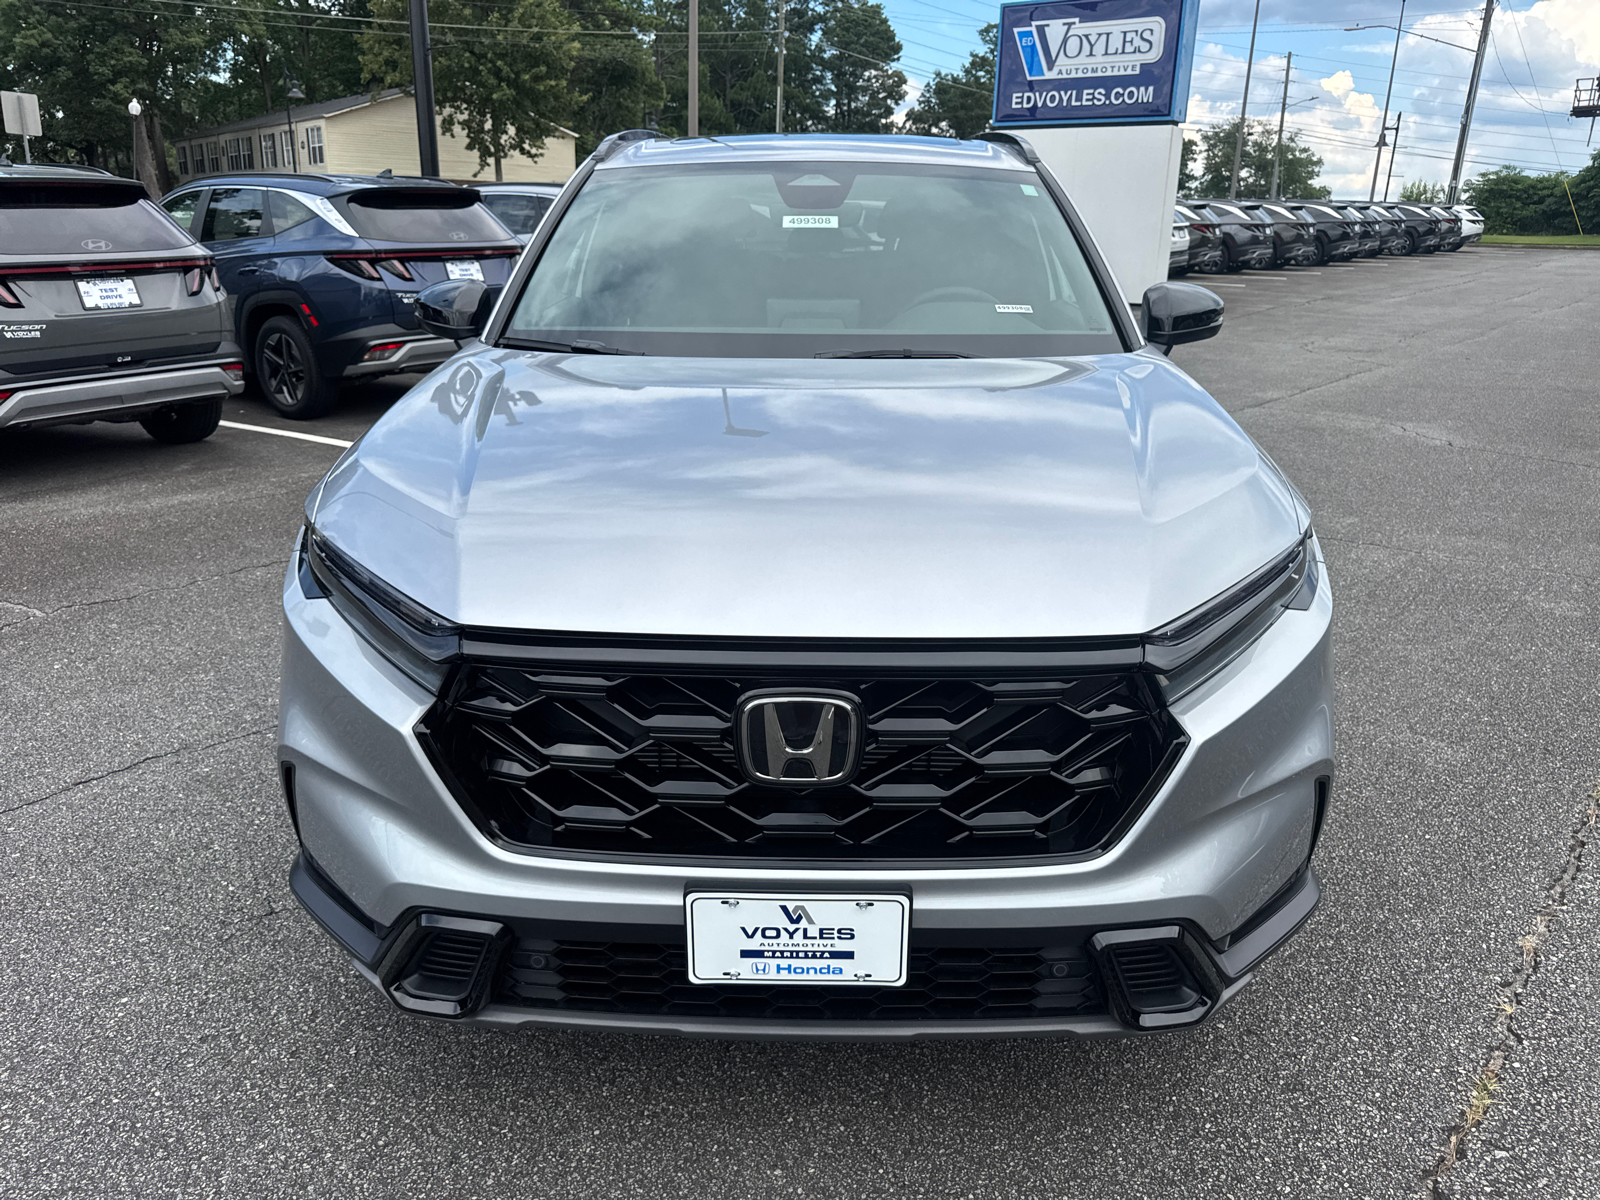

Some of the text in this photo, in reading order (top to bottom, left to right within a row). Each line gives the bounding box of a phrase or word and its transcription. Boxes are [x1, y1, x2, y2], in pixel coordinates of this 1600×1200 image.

[1021, 37, 1034, 46] ED
[1034, 22, 1154, 71] VOYLES
[1056, 63, 1138, 76] AUTOMOTIVE
[1011, 85, 1154, 109] EDVOYLES.COM
[788, 217, 831, 225] 499308
[739, 926, 856, 941] VOYLES
[758, 941, 837, 949] AUTOMOTIVE
[763, 950, 831, 959] MARIETTA
[775, 963, 844, 976] Honda
